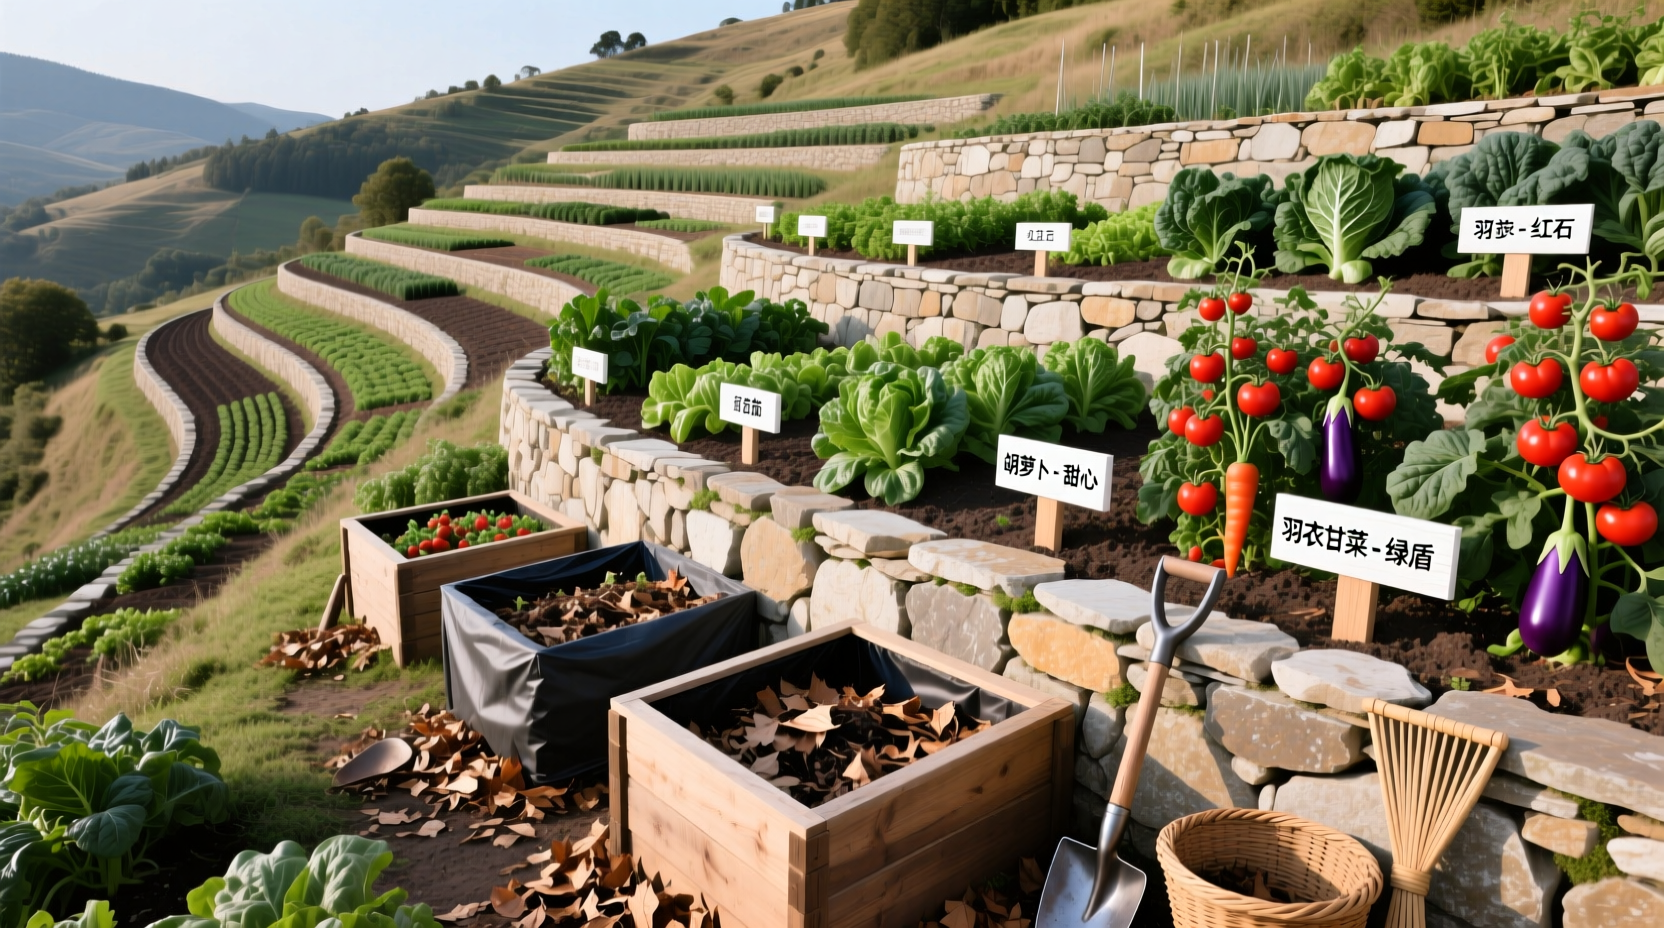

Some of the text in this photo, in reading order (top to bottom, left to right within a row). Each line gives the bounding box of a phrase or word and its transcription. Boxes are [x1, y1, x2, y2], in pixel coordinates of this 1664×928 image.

[1281, 516, 1435, 572] 羽衣甘菜-绿盾
